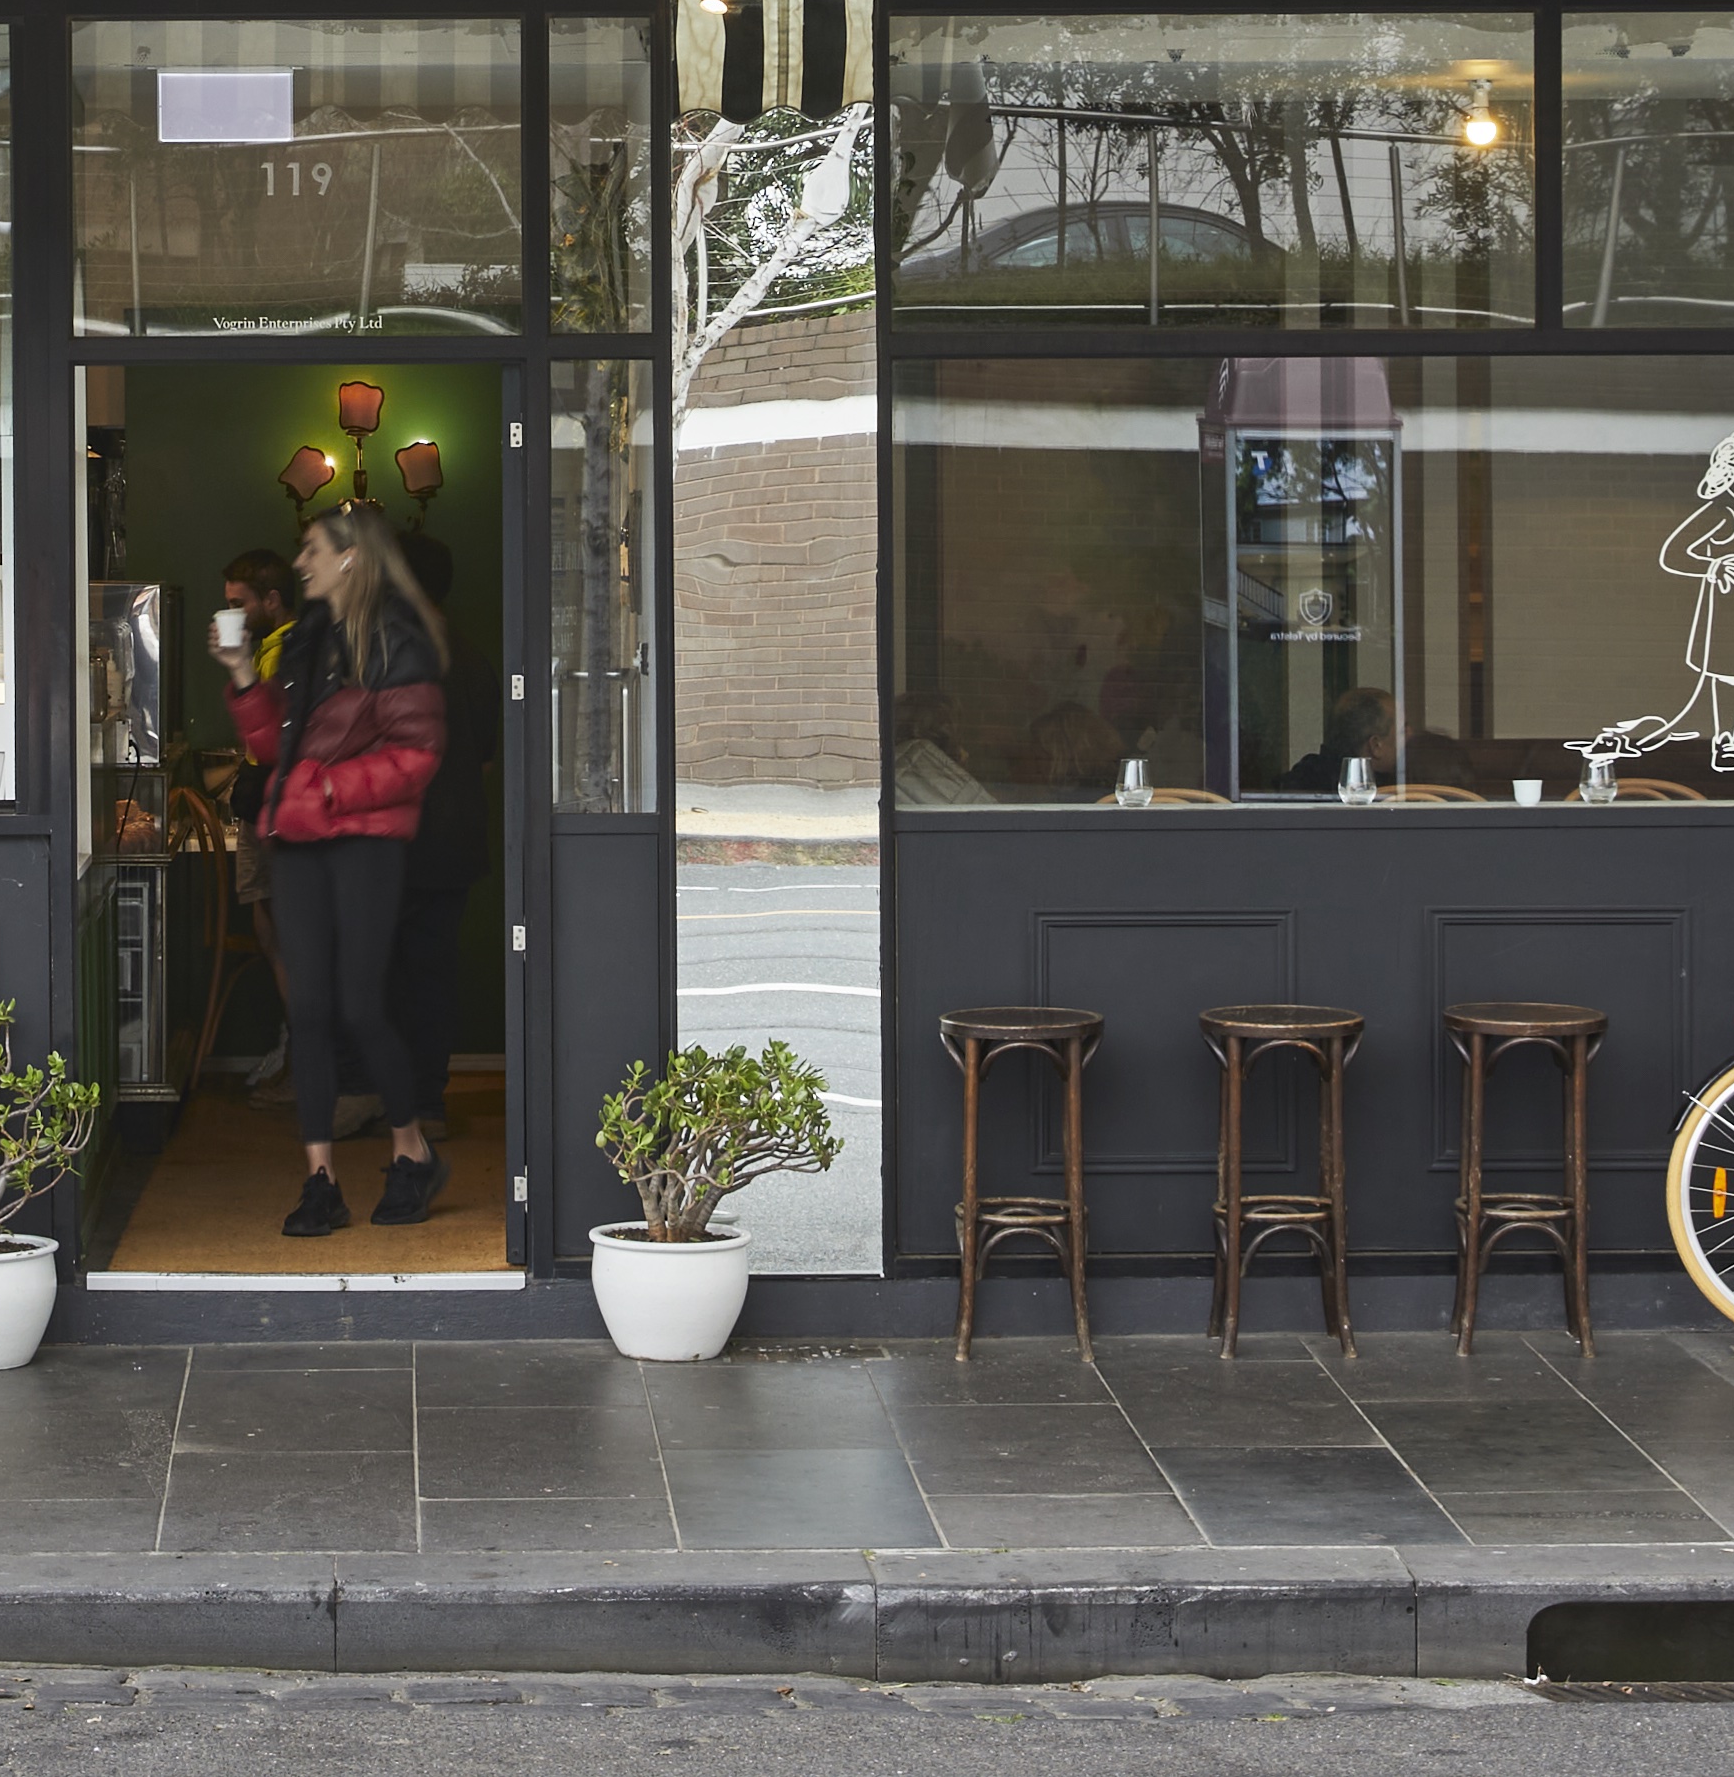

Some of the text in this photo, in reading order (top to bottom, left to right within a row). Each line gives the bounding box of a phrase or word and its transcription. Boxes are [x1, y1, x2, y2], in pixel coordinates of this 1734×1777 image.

[260, 162, 333, 196] 119
[212, 315, 383, 334] Vogrin Enterprises Pty Ltd
